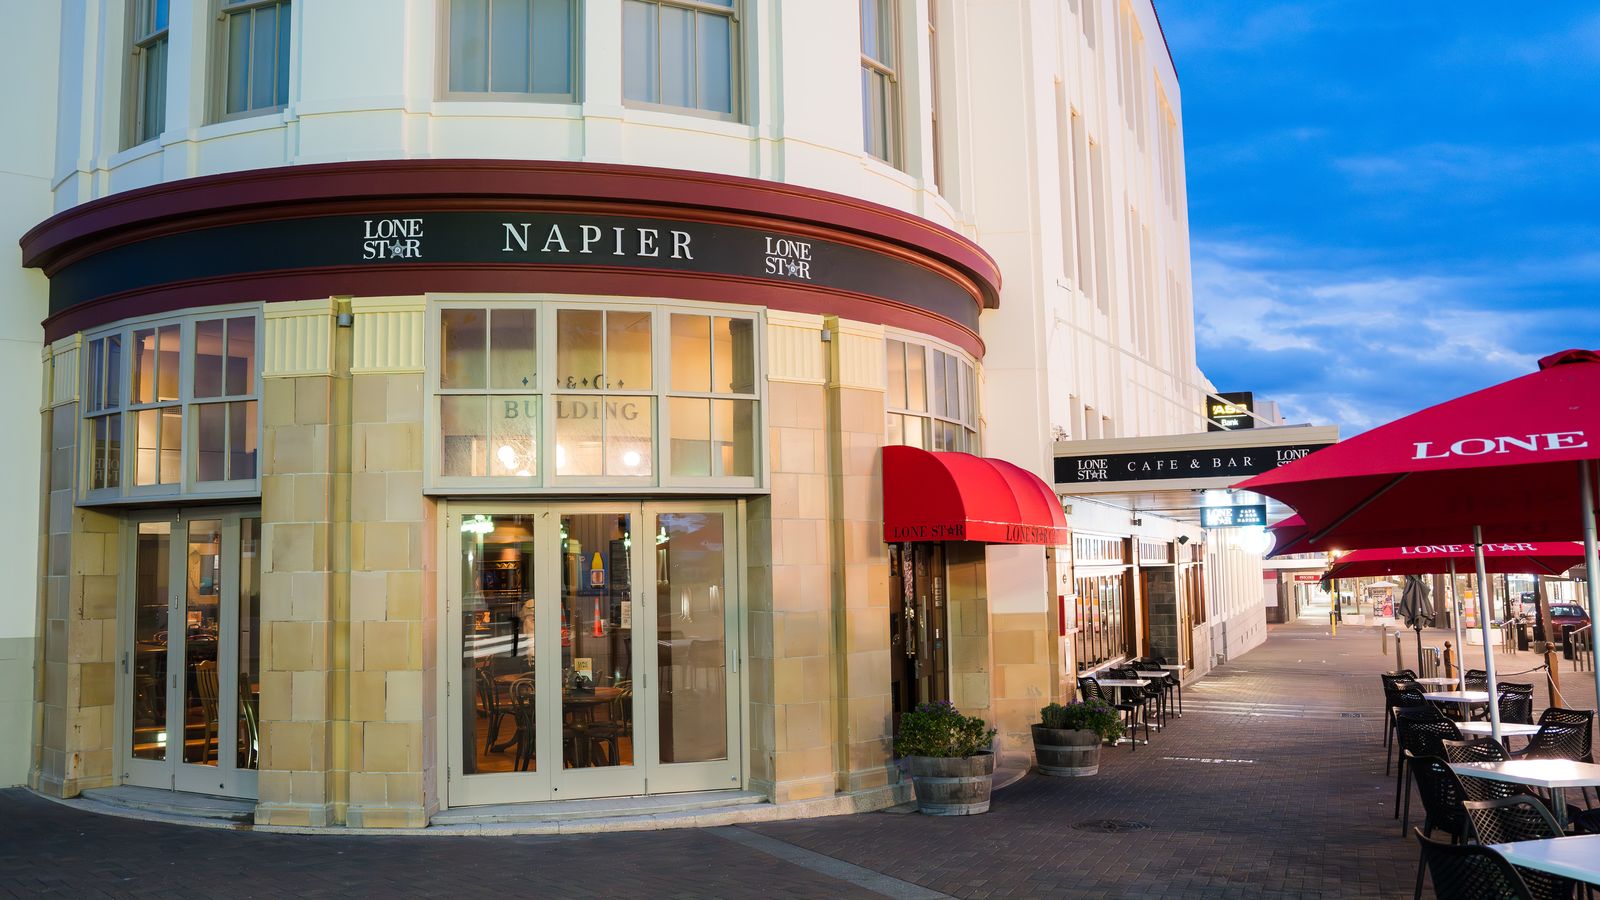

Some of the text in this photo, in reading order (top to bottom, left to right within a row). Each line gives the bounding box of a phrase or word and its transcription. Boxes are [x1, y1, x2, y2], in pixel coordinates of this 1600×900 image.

[363, 218, 423, 239] LONE
[502, 222, 694, 260] NAPIER
[765, 236, 812, 261] LONE
[504, 400, 639, 421] BULDING
[1221, 418, 1239, 427] Bank
[1411, 430, 1588, 460] LONE
[1078, 459, 1108, 470] LONE
[1127, 456, 1253, 472] CAFE & BAR
[893, 525, 928, 538] LONE
[1006, 524, 1030, 543] LONE
[1401, 545, 1464, 554] LONE
